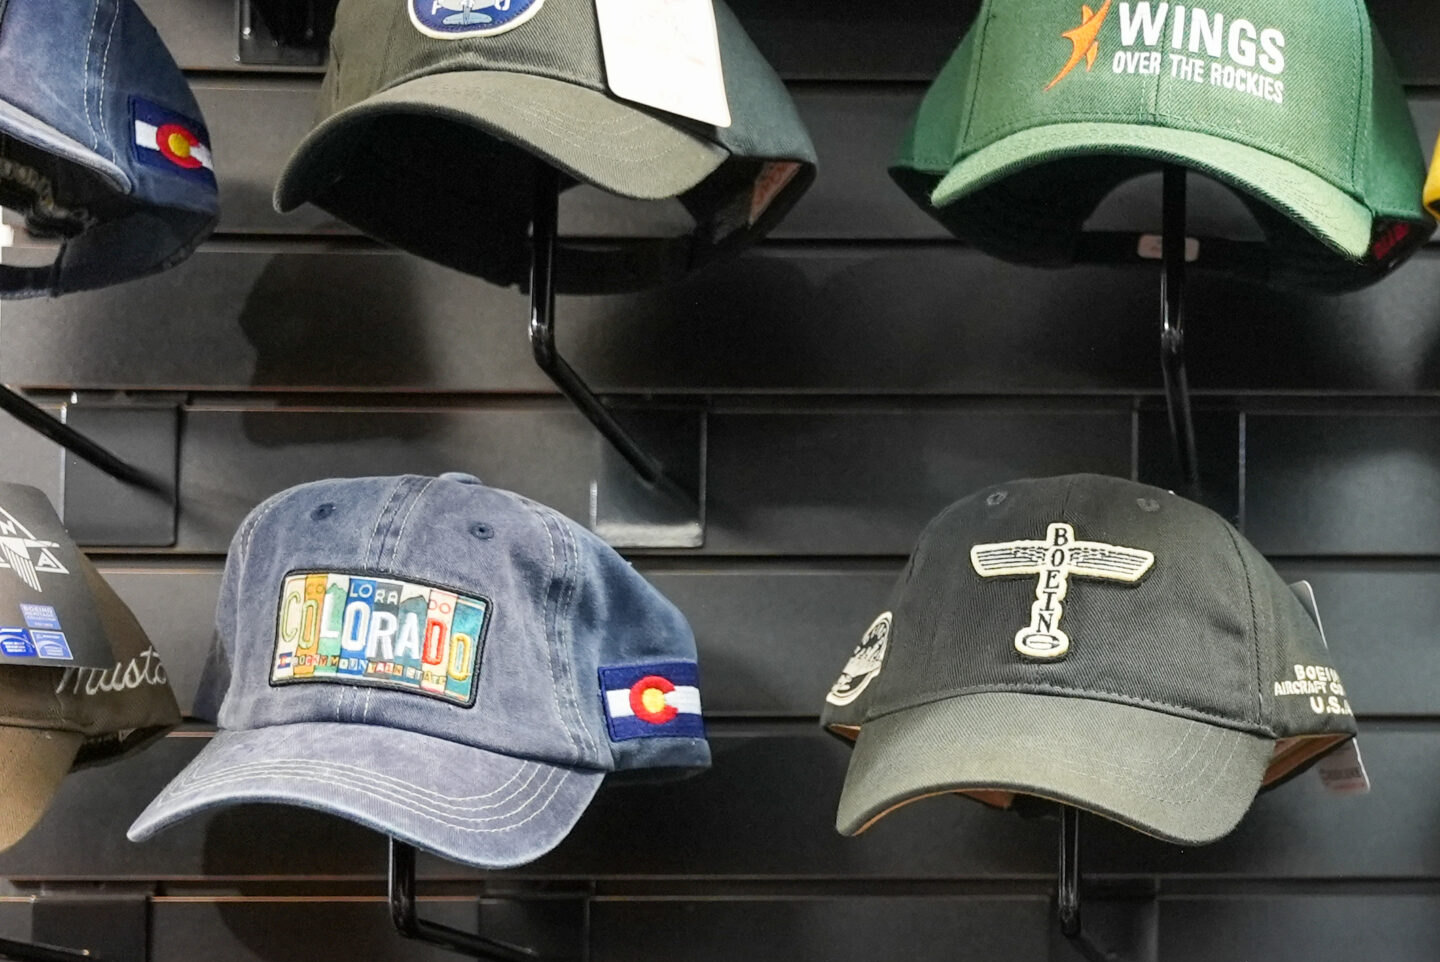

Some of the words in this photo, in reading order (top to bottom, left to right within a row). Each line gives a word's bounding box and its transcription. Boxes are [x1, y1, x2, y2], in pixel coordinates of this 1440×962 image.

[1118, 0, 1286, 75] WINGS
[1112, 51, 1162, 75] OVER
[1169, 54, 1205, 83] THE
[1210, 63, 1284, 104] ROCKIES
[1022, 527, 1069, 651] BOEING
[281, 590, 473, 682] COLORADO
[331, 655, 404, 677] MOUNTAIN
[406, 666, 447, 685] STATE
[1274, 680, 1328, 697] AIRCRAFT
